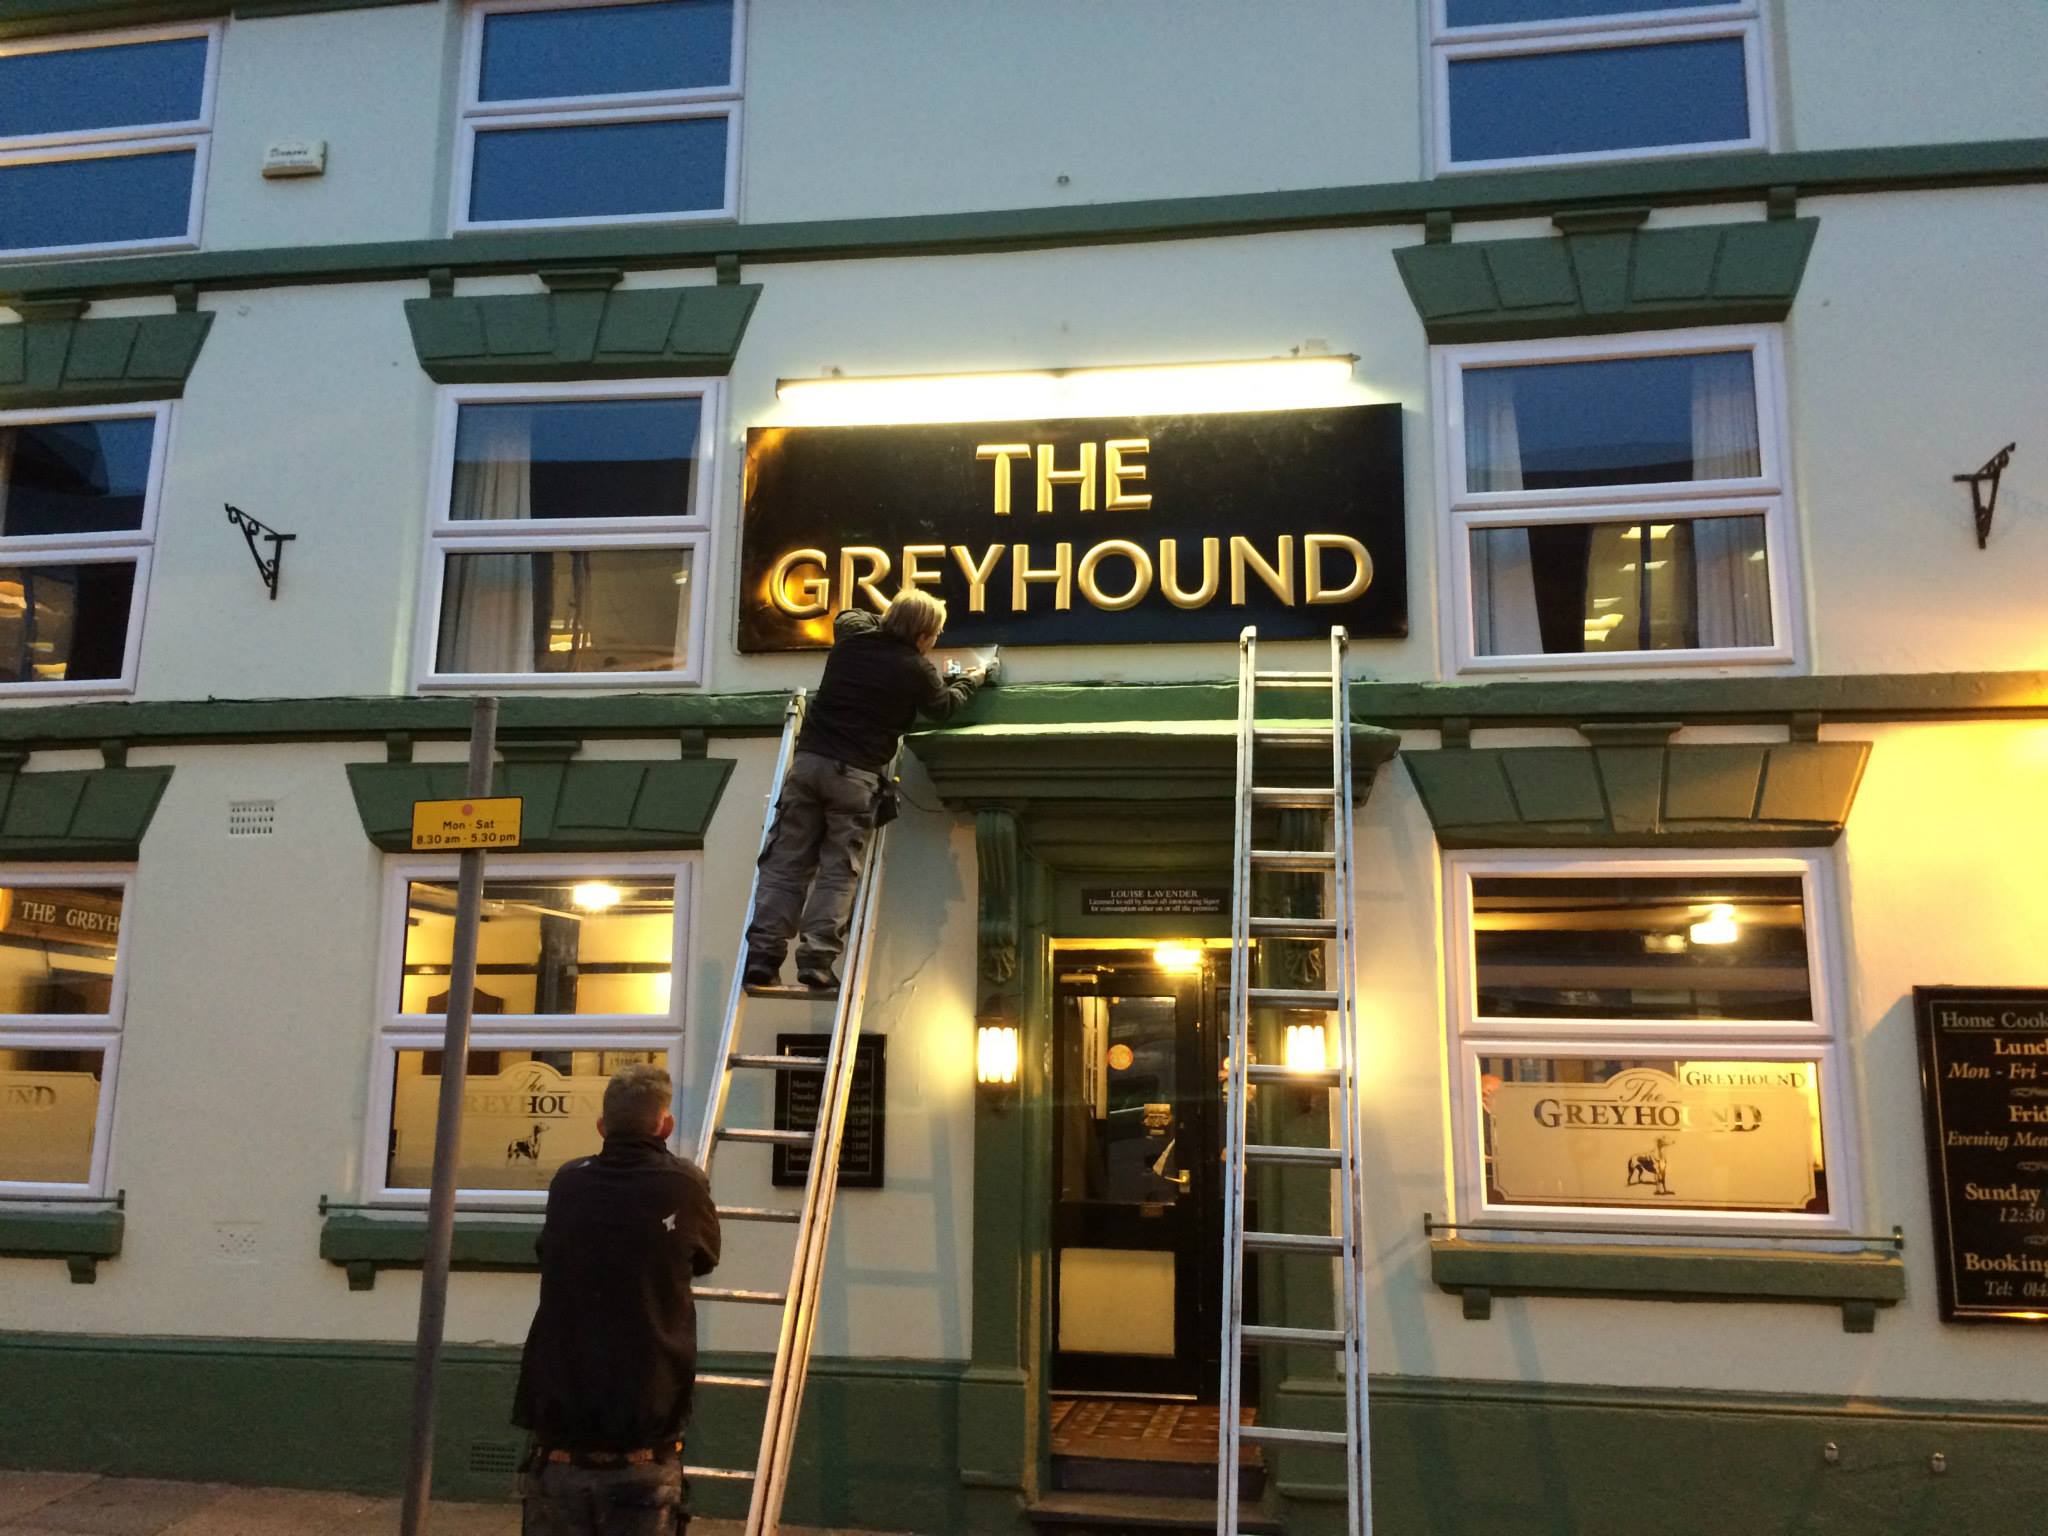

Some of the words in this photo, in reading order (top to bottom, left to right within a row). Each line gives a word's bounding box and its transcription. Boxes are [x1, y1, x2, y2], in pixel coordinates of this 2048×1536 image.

[976, 439, 1152, 514] THE
[769, 534, 1373, 619] GREYHOUND
[443, 821, 465, 831] Mon
[475, 820, 494, 829] Sat
[416, 835, 442, 845] 8.30
[444, 836, 460, 844] am
[471, 833, 496, 842] 5.30
[500, 834, 516, 842] pm
[1110, 890, 1144, 898] LOUISE
[1147, 890, 1198, 898] LAVENDER
[21, 901, 56, 923] THE
[1941, 1011, 1995, 1028] Home
[1993, 1038, 2048, 1055] Lunc
[1948, 1062, 1991, 1079] Mon
[2008, 1062, 2037, 1079] Fri
[1619, 1078, 1666, 1103] The
[1948, 1131, 2009, 1151] Evening
[1965, 1183, 2041, 1207] Sunday
[2000, 1207, 2046, 1222] 12:30
[1984, 1281, 2013, 1296] Tel:
[2023, 1281, 2048, 1297] 014
